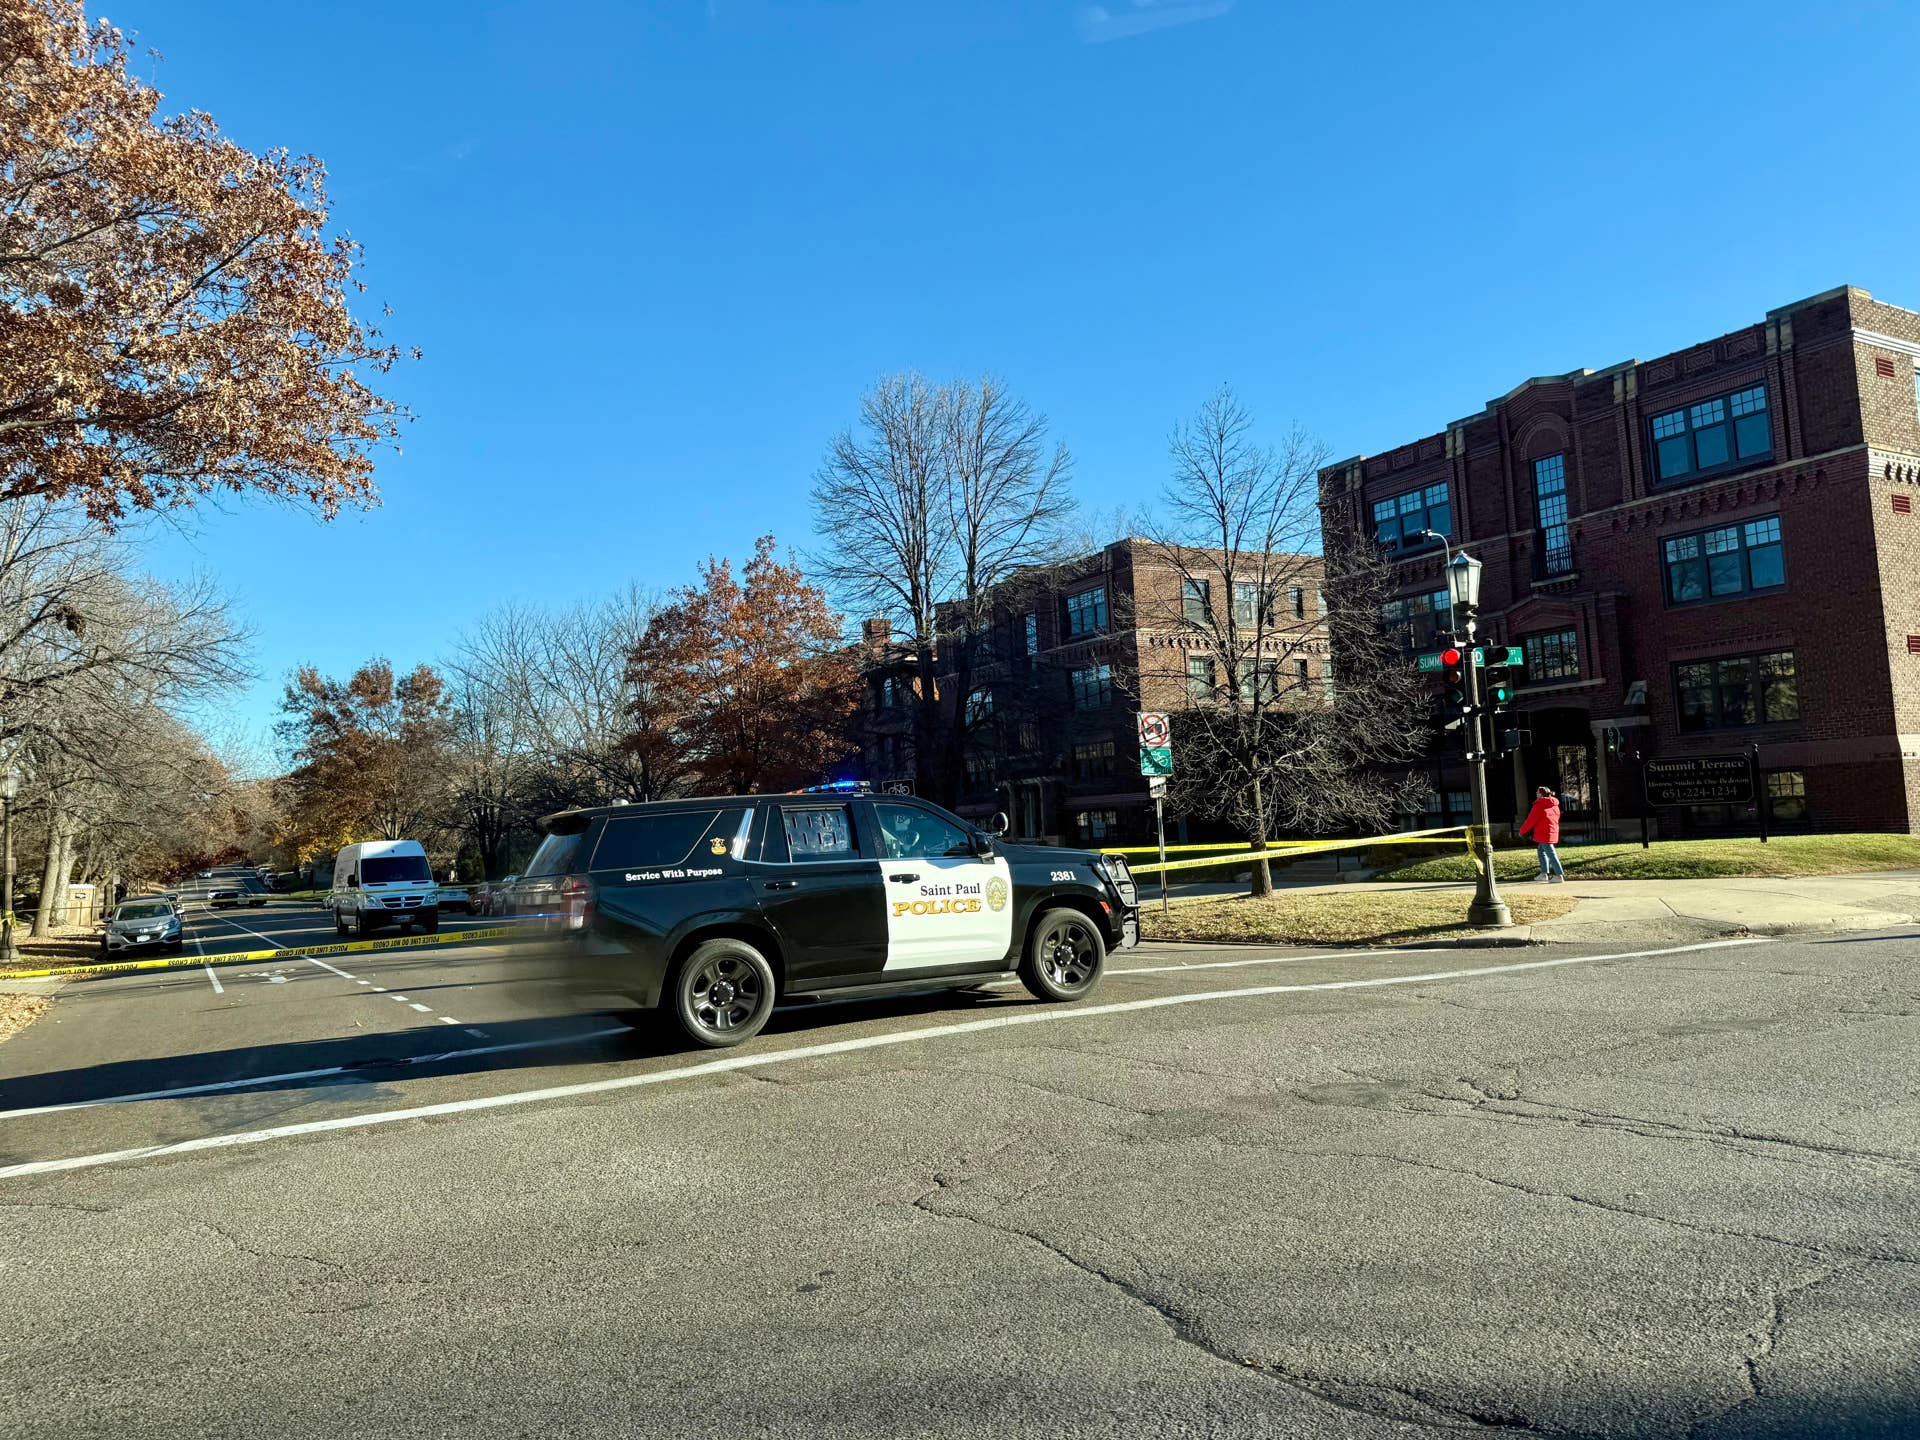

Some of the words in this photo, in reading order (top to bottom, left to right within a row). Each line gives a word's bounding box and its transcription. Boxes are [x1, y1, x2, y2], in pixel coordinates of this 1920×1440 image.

[1420, 656, 1442, 668] SUMM
[1648, 761, 1696, 772] Summit
[1698, 760, 1744, 769] Terrace
[1662, 786, 1738, 798] 651-224-1234
[626, 872, 660, 882] Service
[662, 870, 685, 878] With
[686, 868, 722, 878] Purpose
[1050, 870, 1076, 882] 2381
[920, 884, 952, 896] Saint
[955, 882, 980, 894] Paul
[893, 898, 981, 916] POLICE
